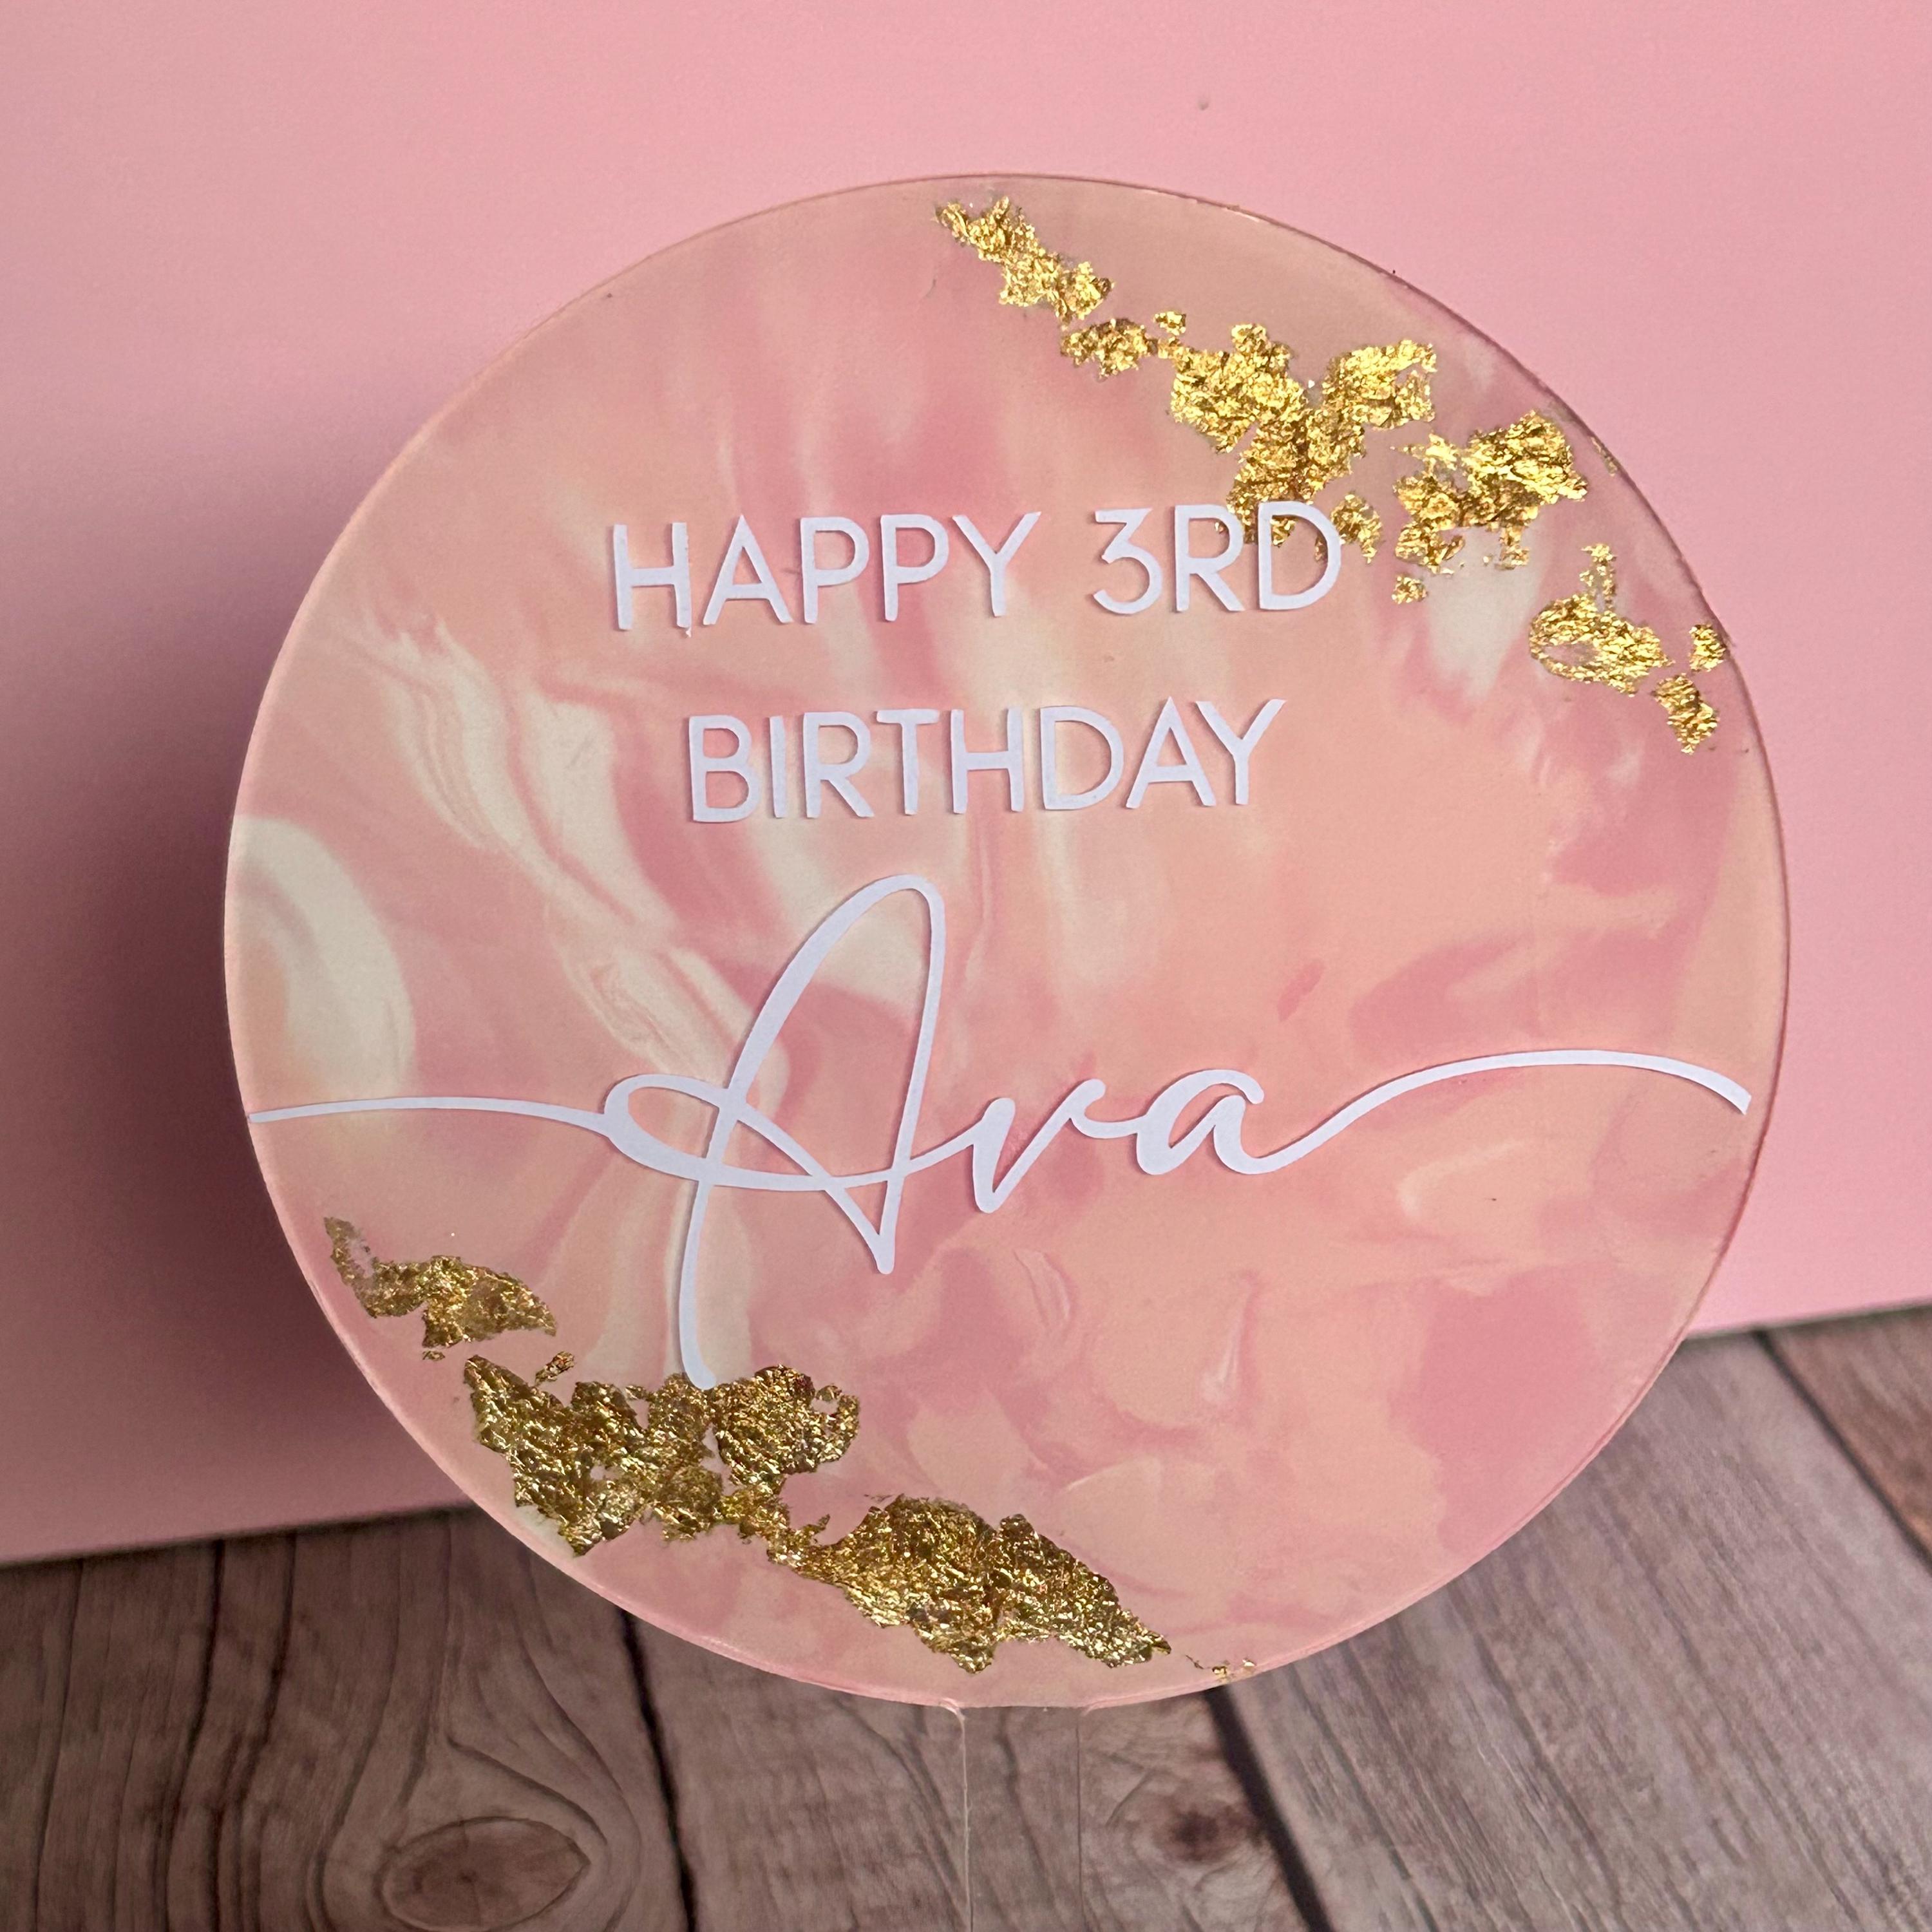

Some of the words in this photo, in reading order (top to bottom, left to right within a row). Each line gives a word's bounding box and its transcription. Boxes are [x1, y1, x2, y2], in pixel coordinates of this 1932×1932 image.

[613, 511, 1041, 632] HAPPY
[1093, 500, 1341, 614] 3RD
[688, 696, 1287, 823] BIRTHDAY
[249, 873, 1752, 1390] Ava
